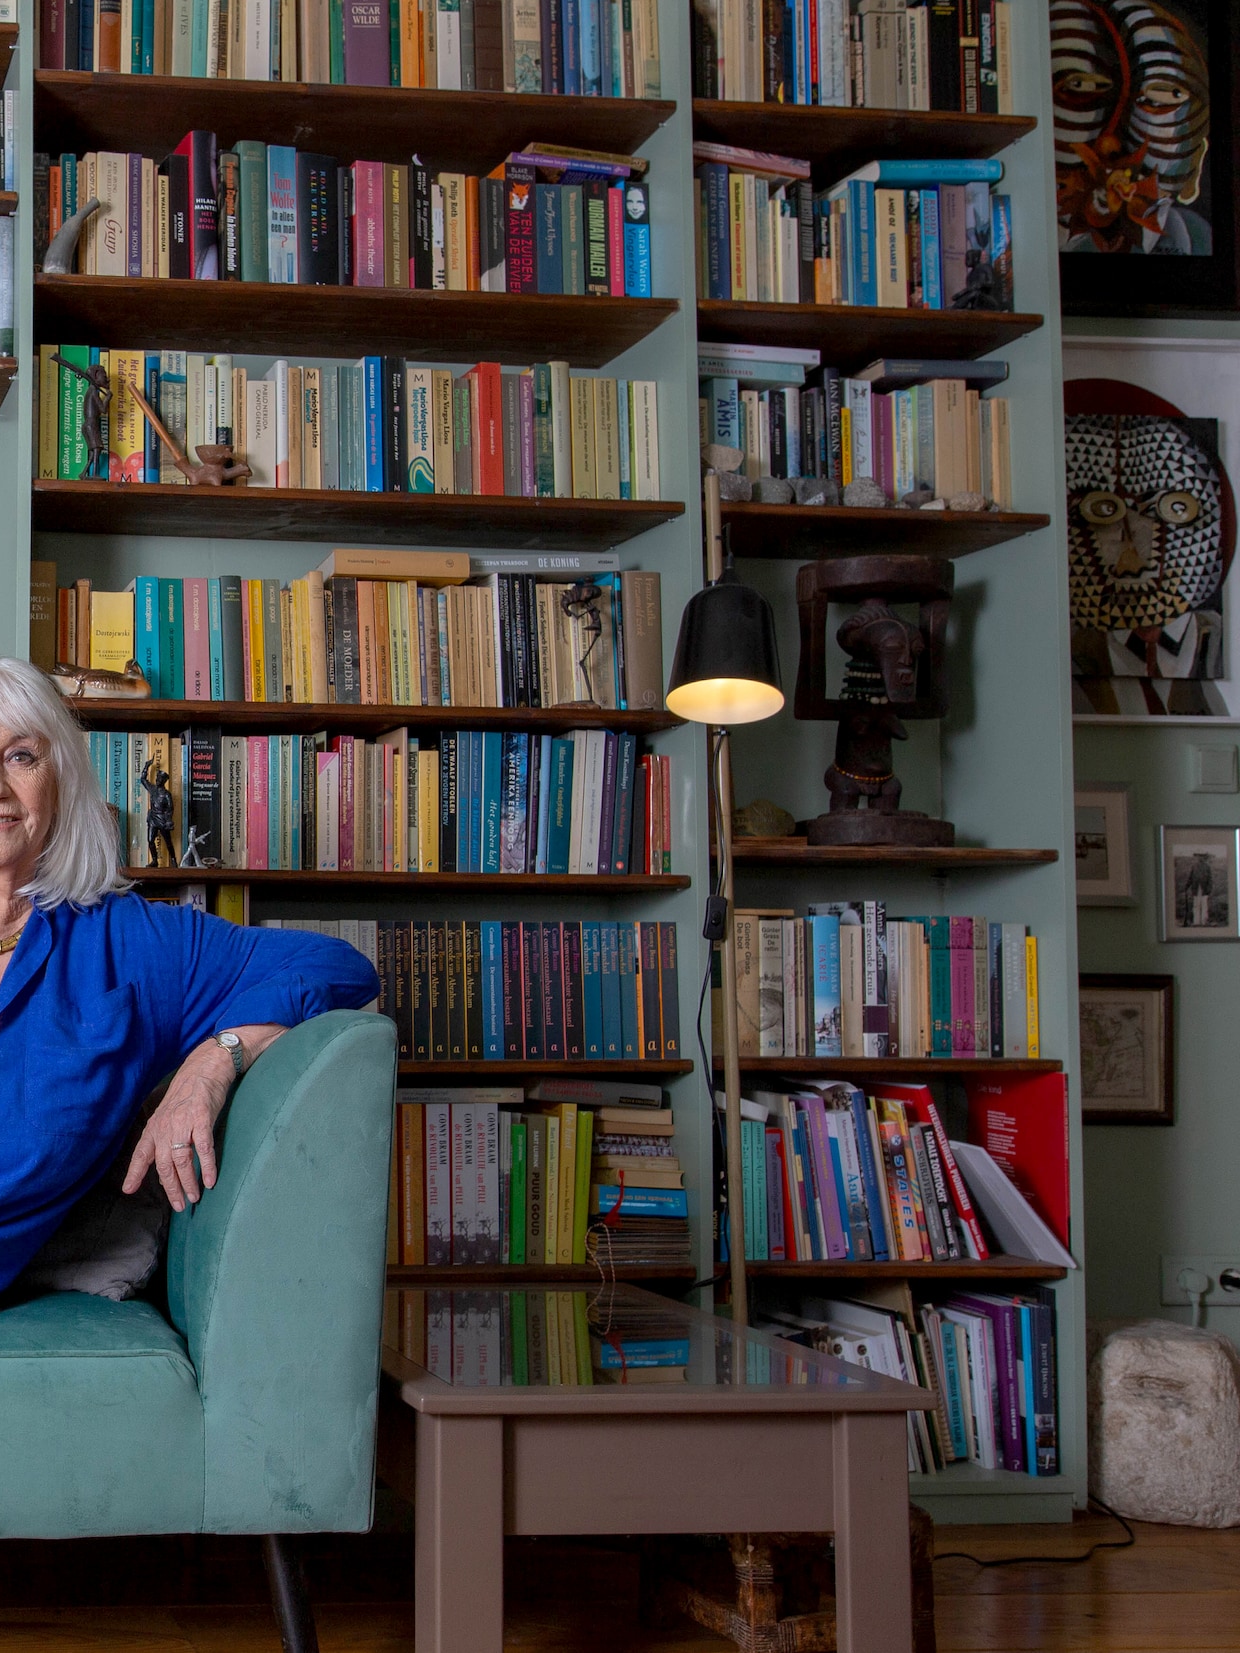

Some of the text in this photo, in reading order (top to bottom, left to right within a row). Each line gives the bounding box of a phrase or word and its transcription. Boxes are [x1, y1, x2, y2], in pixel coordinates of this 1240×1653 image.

[352, 6, 380, 15] OSCAR
[352, 16, 380, 24] WILDE
[981, 33, 992, 83] ENIGMA
[270, 190, 296, 208] Wolfe
[274, 173, 291, 190] Tom
[510, 211, 519, 235] VAN
[510, 239, 519, 255] DE
[521, 212, 532, 282] TEN ZUIDEN
[589, 199, 605, 277] NORMAN MAILER
[627, 228, 637, 287] Vingervlug
[118, 358, 127, 442] Zuid-Amerika leesboek
[441, 401, 450, 425] Vargas
[717, 398, 730, 437] AMIS
[728, 389, 736, 421] MARTIN
[831, 378, 841, 452] IAN MCEWAN
[538, 558, 580, 568] DE KONING
[344, 630, 354, 691] DE MOEDER
[507, 753, 515, 849] AMERIKA EENHOOG
[877, 906, 886, 933] Anna
[819, 944, 828, 982] ICARIË
[830, 933, 838, 992] UWE TIMM
[866, 905, 875, 995] Het zevende kruis
[487, 1111, 496, 1163] CONNY BRAAM
[927, 1103, 971, 1210] INTERCULTUREEL PIONIEREN
[894, 1155, 913, 1228] STATES
[916, 1150, 934, 1204] SCHRIJVERS
[924, 1130, 946, 1202] FATALE ZOEKTOCHT
[531, 1171, 540, 1235] PUUR GOUD
